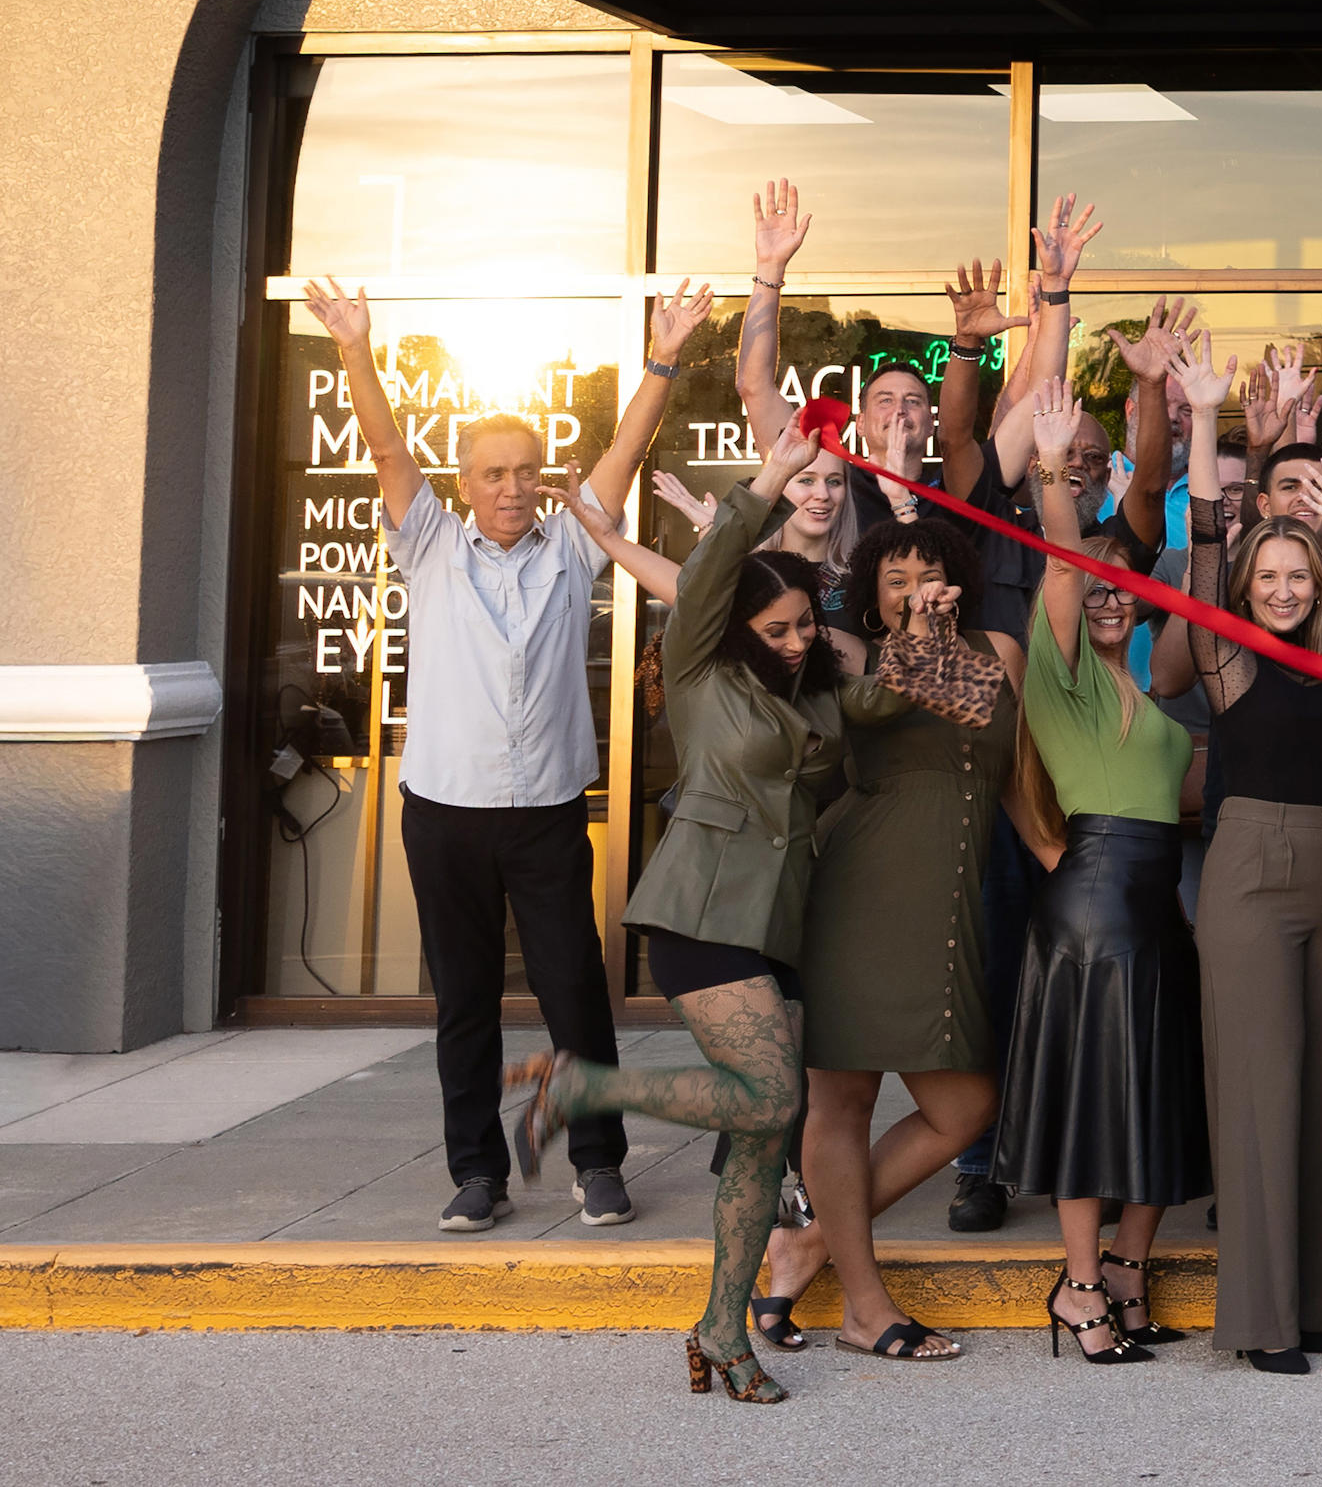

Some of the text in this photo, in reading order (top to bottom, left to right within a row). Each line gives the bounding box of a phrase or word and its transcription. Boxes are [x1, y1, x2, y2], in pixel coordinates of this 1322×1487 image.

[308, 369, 584, 408] PEMANT
[311, 413, 582, 466] MKEP
[298, 585, 408, 620] NANO
